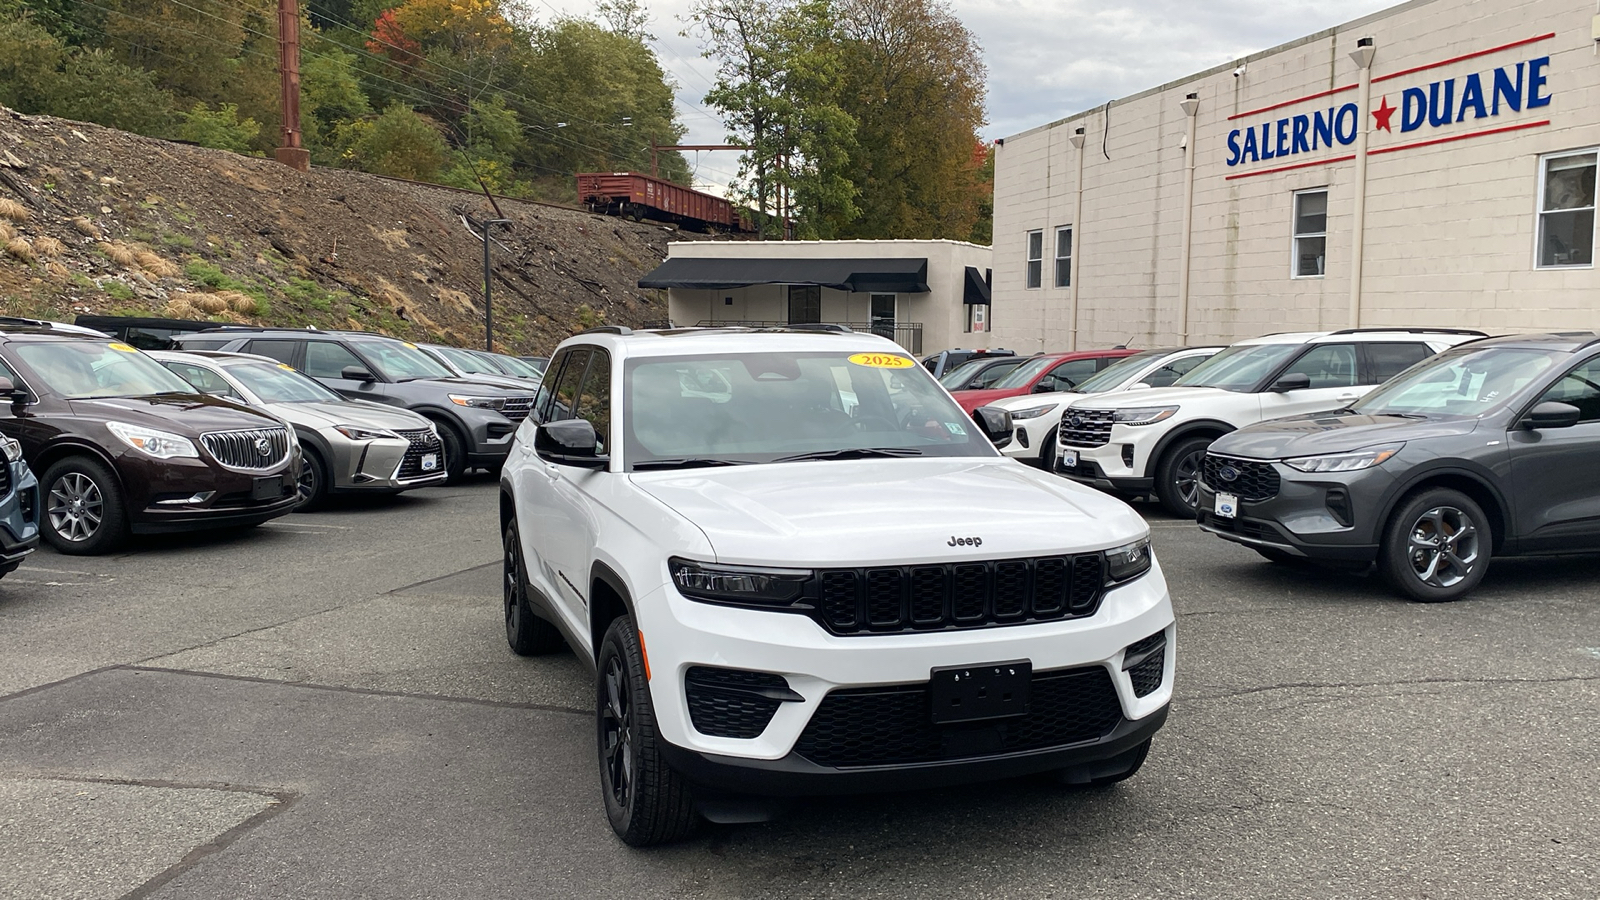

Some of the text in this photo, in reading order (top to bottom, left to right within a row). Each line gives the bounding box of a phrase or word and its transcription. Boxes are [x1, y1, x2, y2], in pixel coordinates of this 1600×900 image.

[1226, 56, 1552, 167] SALERNO DUANE
[861, 355, 903, 366] 2025
[946, 535, 983, 548] Jeep
